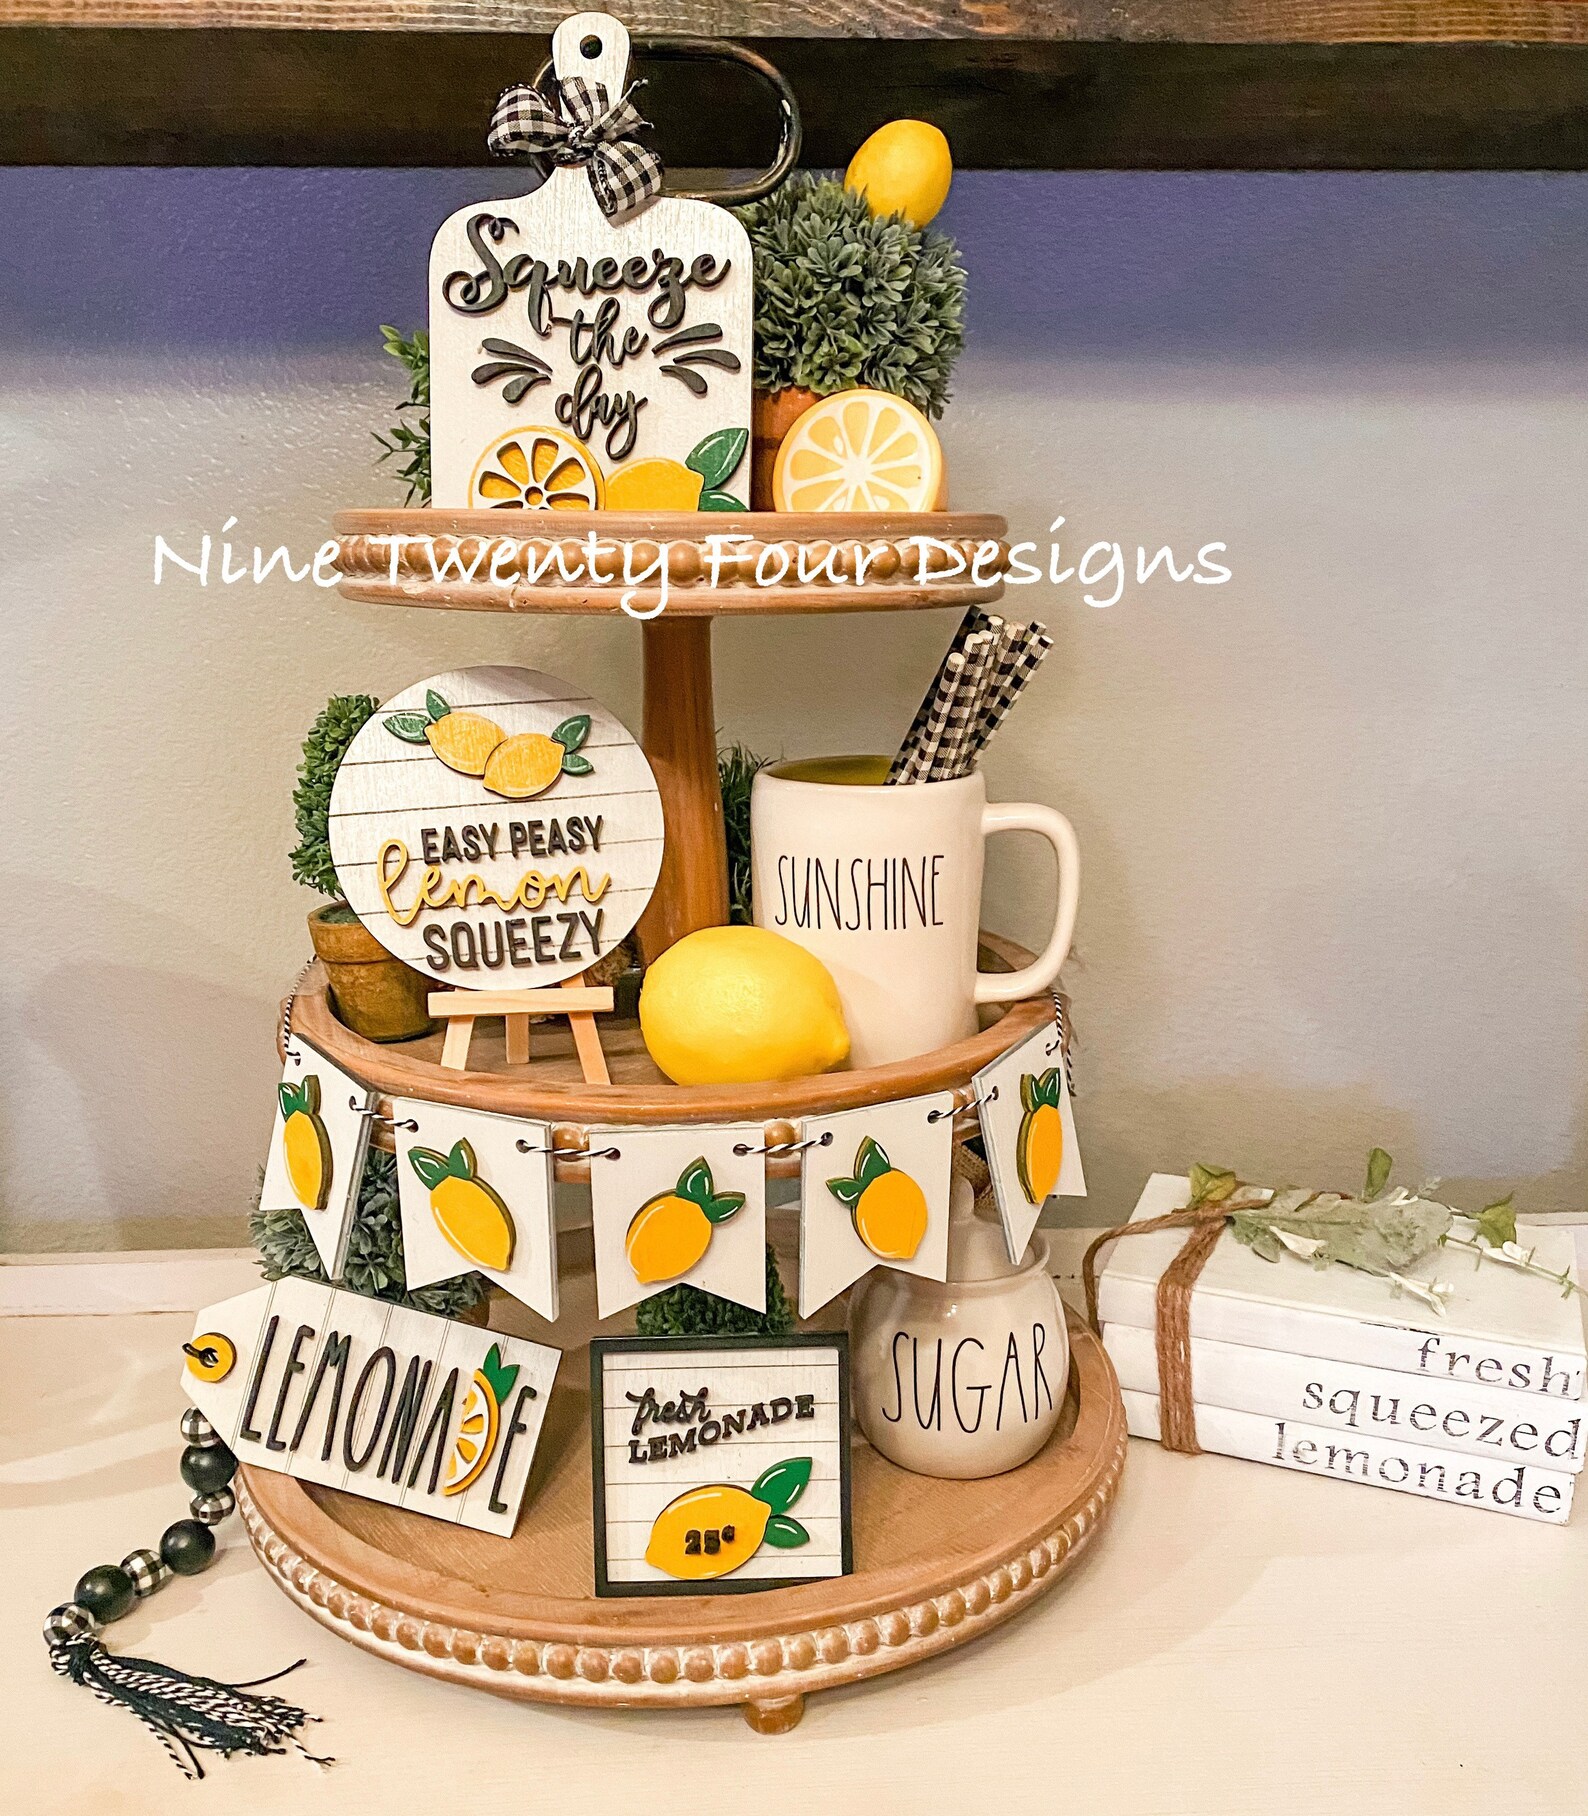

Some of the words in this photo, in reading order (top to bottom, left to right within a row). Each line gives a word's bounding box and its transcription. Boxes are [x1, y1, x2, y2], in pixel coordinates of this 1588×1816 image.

[443, 213, 731, 337] Squeeze
[551, 297, 650, 366] the
[555, 364, 648, 461] day
[421, 822, 498, 865] EASY
[509, 815, 602, 859] PEASY
[377, 838, 611, 926] lemon
[775, 854, 944, 930] SUNSHINE
[423, 908, 603, 971] SQUEEZY
[882, 1322, 1052, 1434] SUGAR
[1418, 1337, 1571, 1396] fresh
[625, 1387, 711, 1436] fresh
[628, 1394, 815, 1464] LEMONADE
[1302, 1382, 1582, 1460] squeezed
[1271, 1422, 1562, 1514] lemonade
